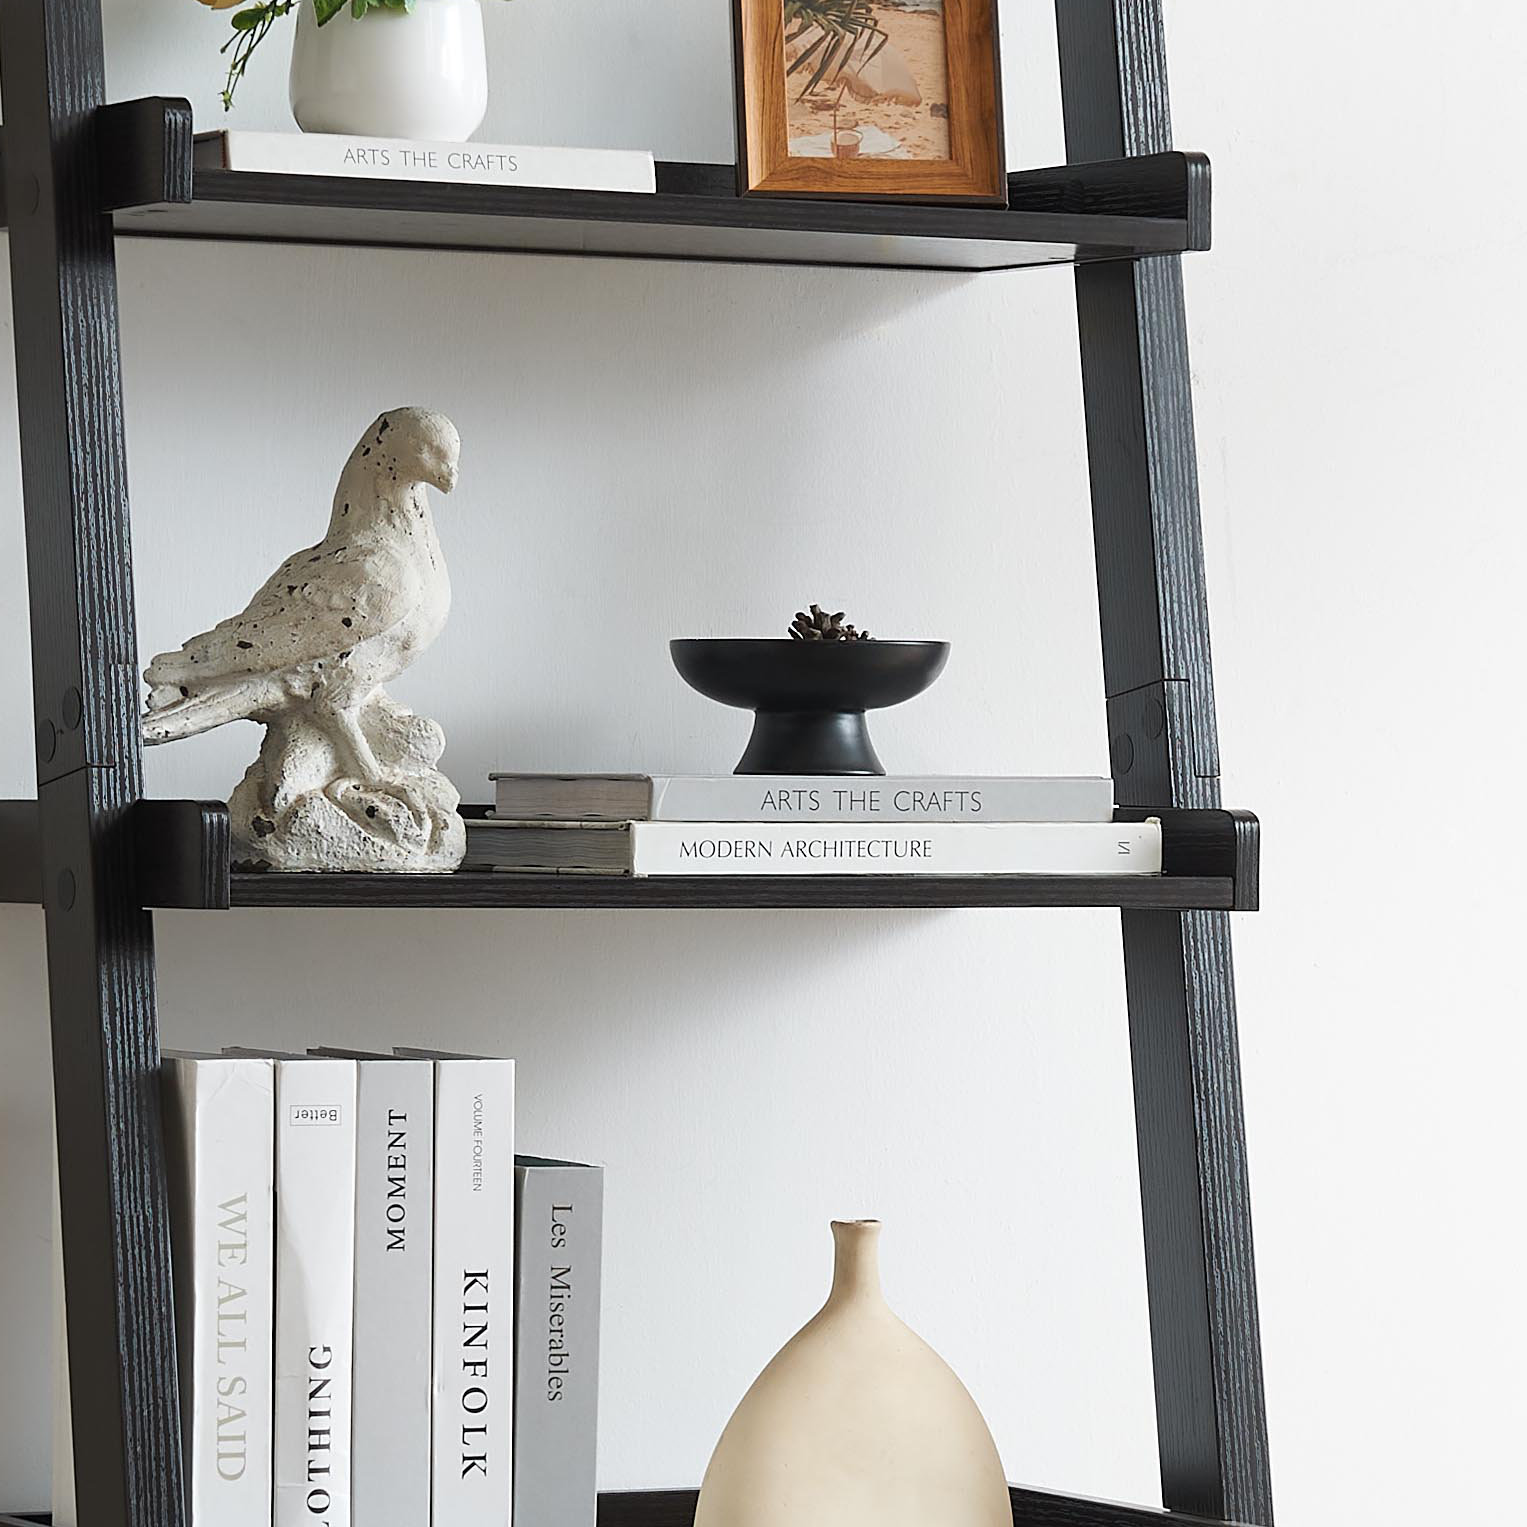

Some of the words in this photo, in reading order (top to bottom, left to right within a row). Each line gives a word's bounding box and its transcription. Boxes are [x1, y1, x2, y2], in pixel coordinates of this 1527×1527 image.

[343, 147, 390, 167] ARTS
[399, 149, 438, 169] THE
[447, 152, 519, 173] CRAFTS
[760, 789, 821, 812] ARTS
[833, 790, 882, 812] THE
[893, 789, 983, 813] CRAFTS
[678, 838, 773, 860] MODERN
[781, 838, 934, 859] ARCHITECTURE
[295, 1109, 338, 1122] Better
[472, 1093, 484, 1137] VOLUME
[385, 1108, 408, 1253] MOMENT
[472, 1139, 483, 1192] FOURTEEN
[216, 1191, 250, 1268] WE
[550, 1201, 573, 1250] Les
[216, 1280, 249, 1366] ALL
[546, 1263, 572, 1403] Miserables
[461, 1268, 489, 1479] KINFOLK
[215, 1374, 249, 1483] SAID
